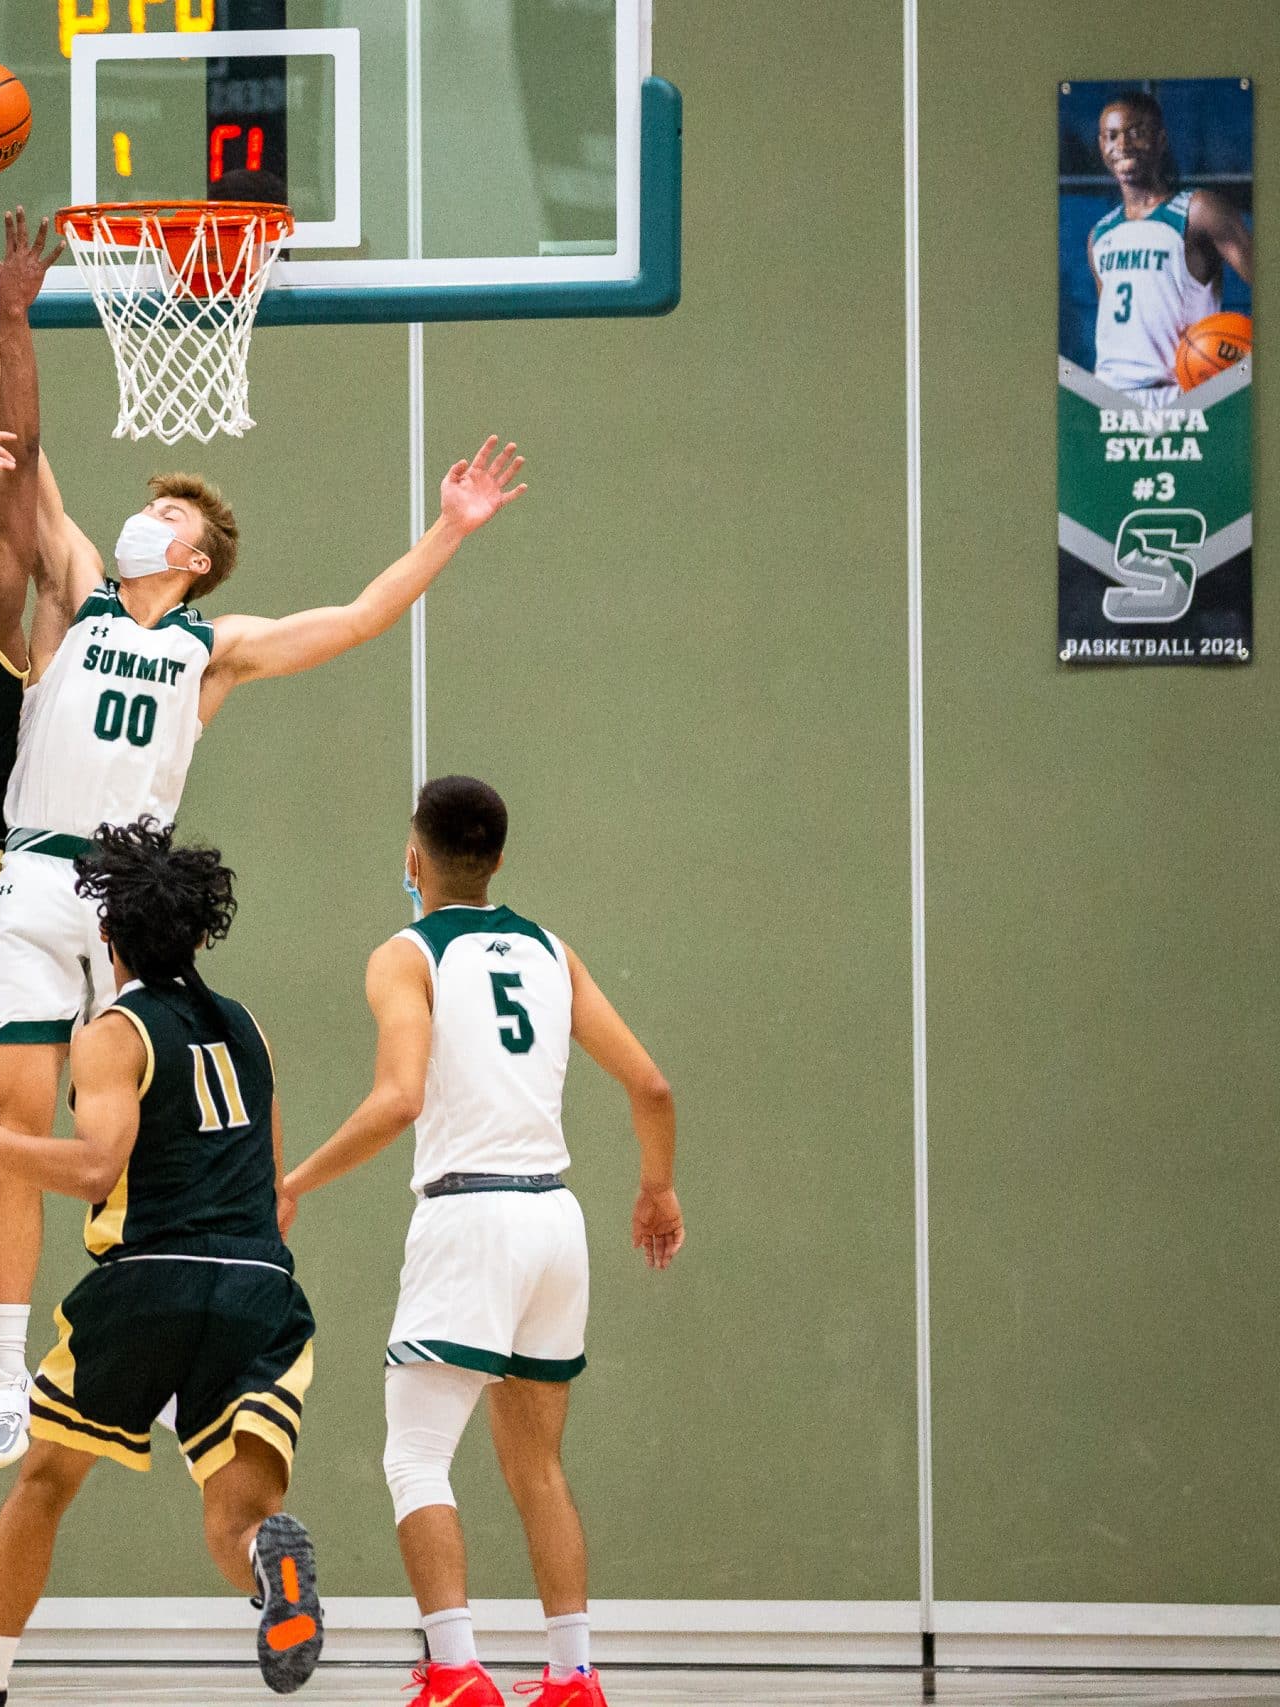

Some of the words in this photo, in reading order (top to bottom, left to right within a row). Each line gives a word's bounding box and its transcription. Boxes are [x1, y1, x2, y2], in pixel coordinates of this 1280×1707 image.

[1099, 249, 1169, 274] SUMMIT
[1113, 282, 1133, 324] 3
[1099, 409, 1209, 433] BANTA
[1105, 438, 1203, 461] SYLLA
[1132, 472, 1175, 501] #3
[1066, 639, 1195, 656] BASKETBALL
[1200, 638, 1243, 655] 2021
[83, 645, 186, 687] SUMMIT
[93, 689, 157, 747] 00
[489, 971, 534, 1055] 5
[187, 1041, 251, 1132] 11
